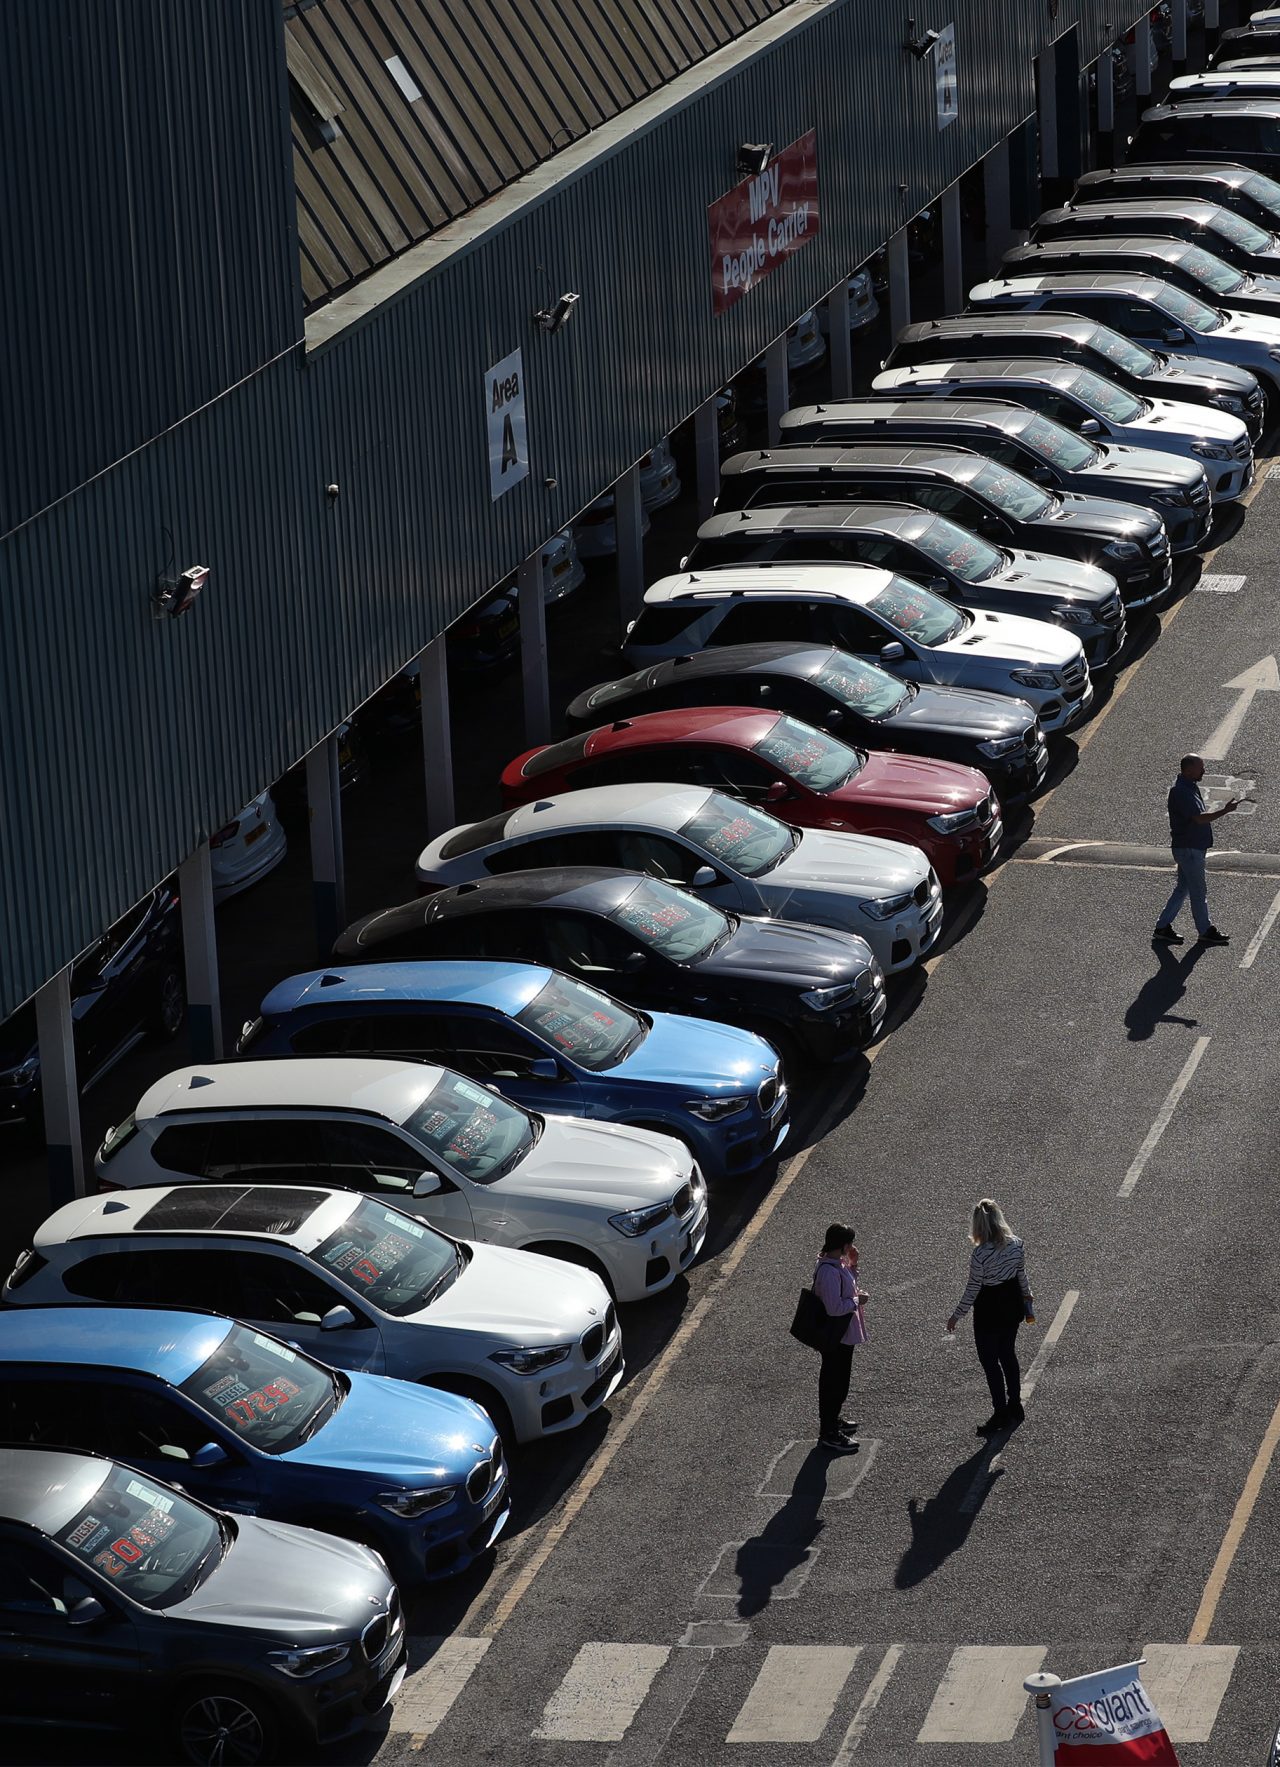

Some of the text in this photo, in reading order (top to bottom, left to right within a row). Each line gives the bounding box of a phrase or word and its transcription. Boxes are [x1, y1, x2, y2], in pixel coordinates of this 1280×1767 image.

[939, 40, 953, 68] Area
[943, 69, 952, 113] A
[749, 163, 780, 224] MPV
[723, 201, 809, 295] People Carrier
[492, 372, 519, 413] Area
[501, 413, 518, 475] A
[336, 1250, 361, 1269] DIESEL
[217, 1384, 248, 1404] DIESEL
[70, 1519, 99, 1545] DIESEL
